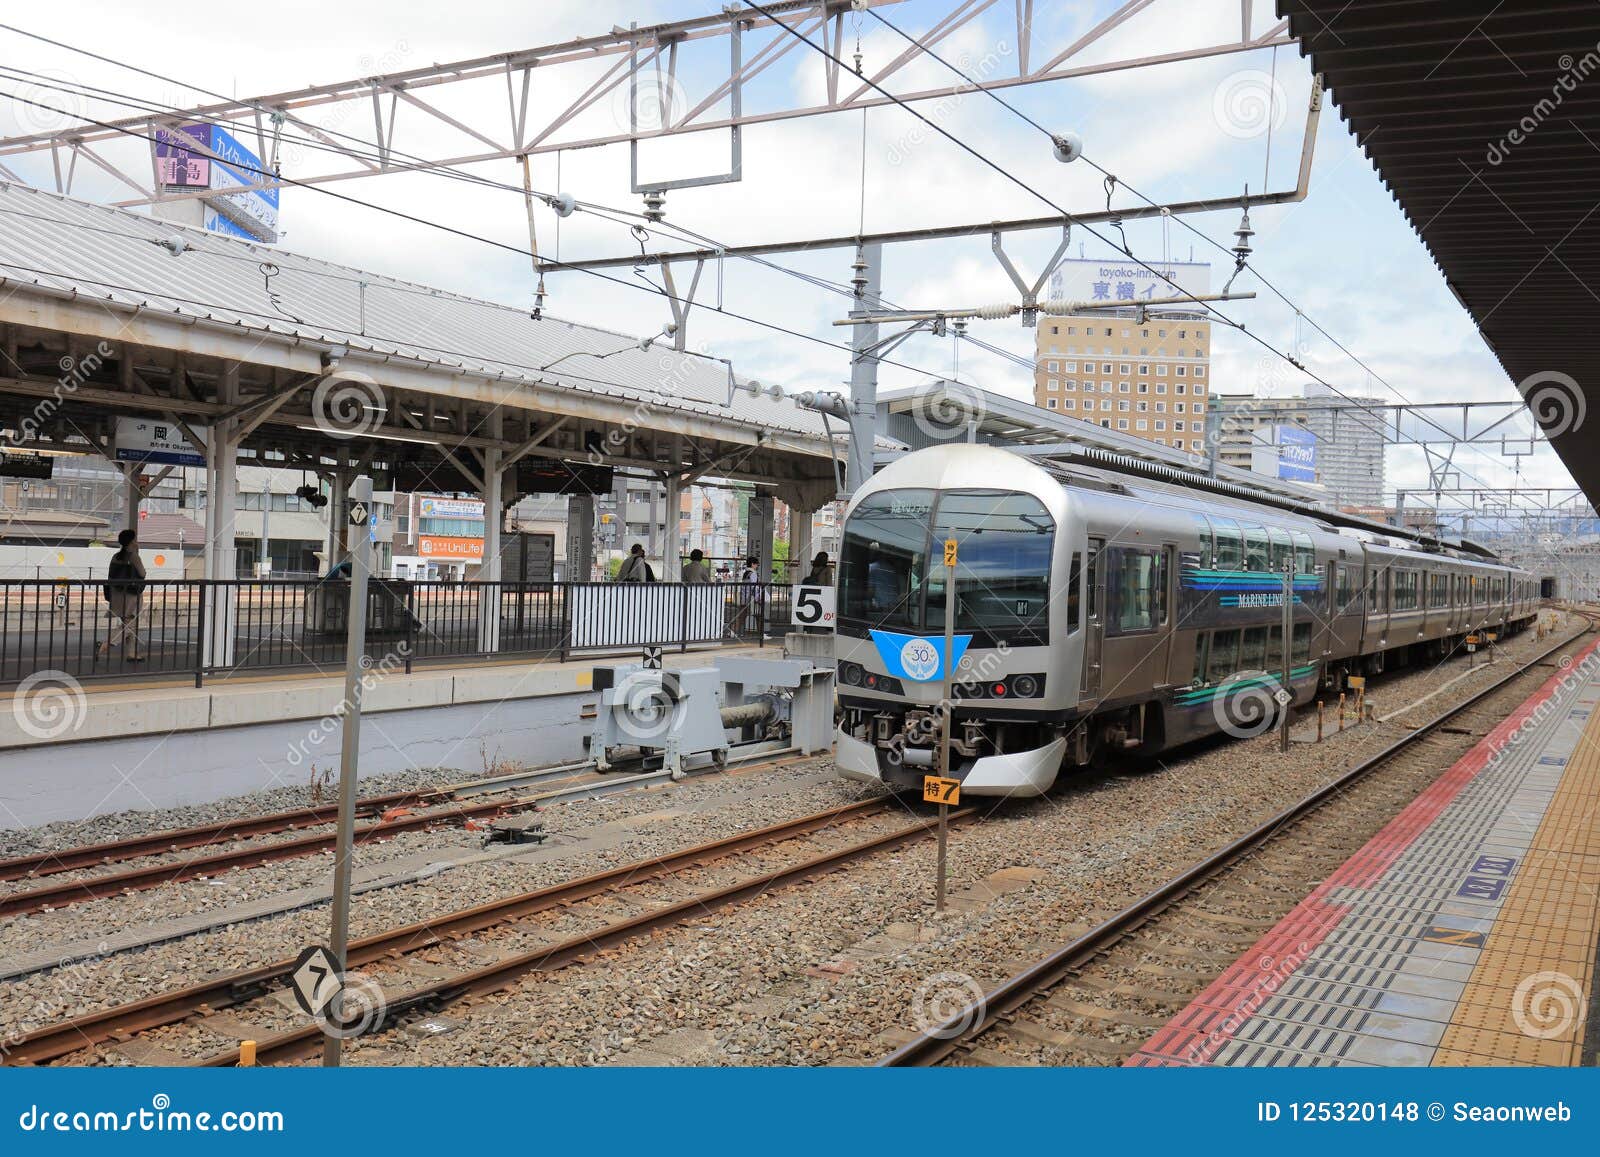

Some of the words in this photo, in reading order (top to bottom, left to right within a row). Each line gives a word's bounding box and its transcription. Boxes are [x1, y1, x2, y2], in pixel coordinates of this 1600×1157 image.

[1092, 281, 1182, 300] 東横イン
[356, 507, 363, 522] 7
[448, 543, 480, 553] UniLife
[796, 588, 823, 623] 5
[1239, 594, 1267, 608] MARINE
[912, 649, 929, 662] 30
[309, 964, 327, 1001] 7
